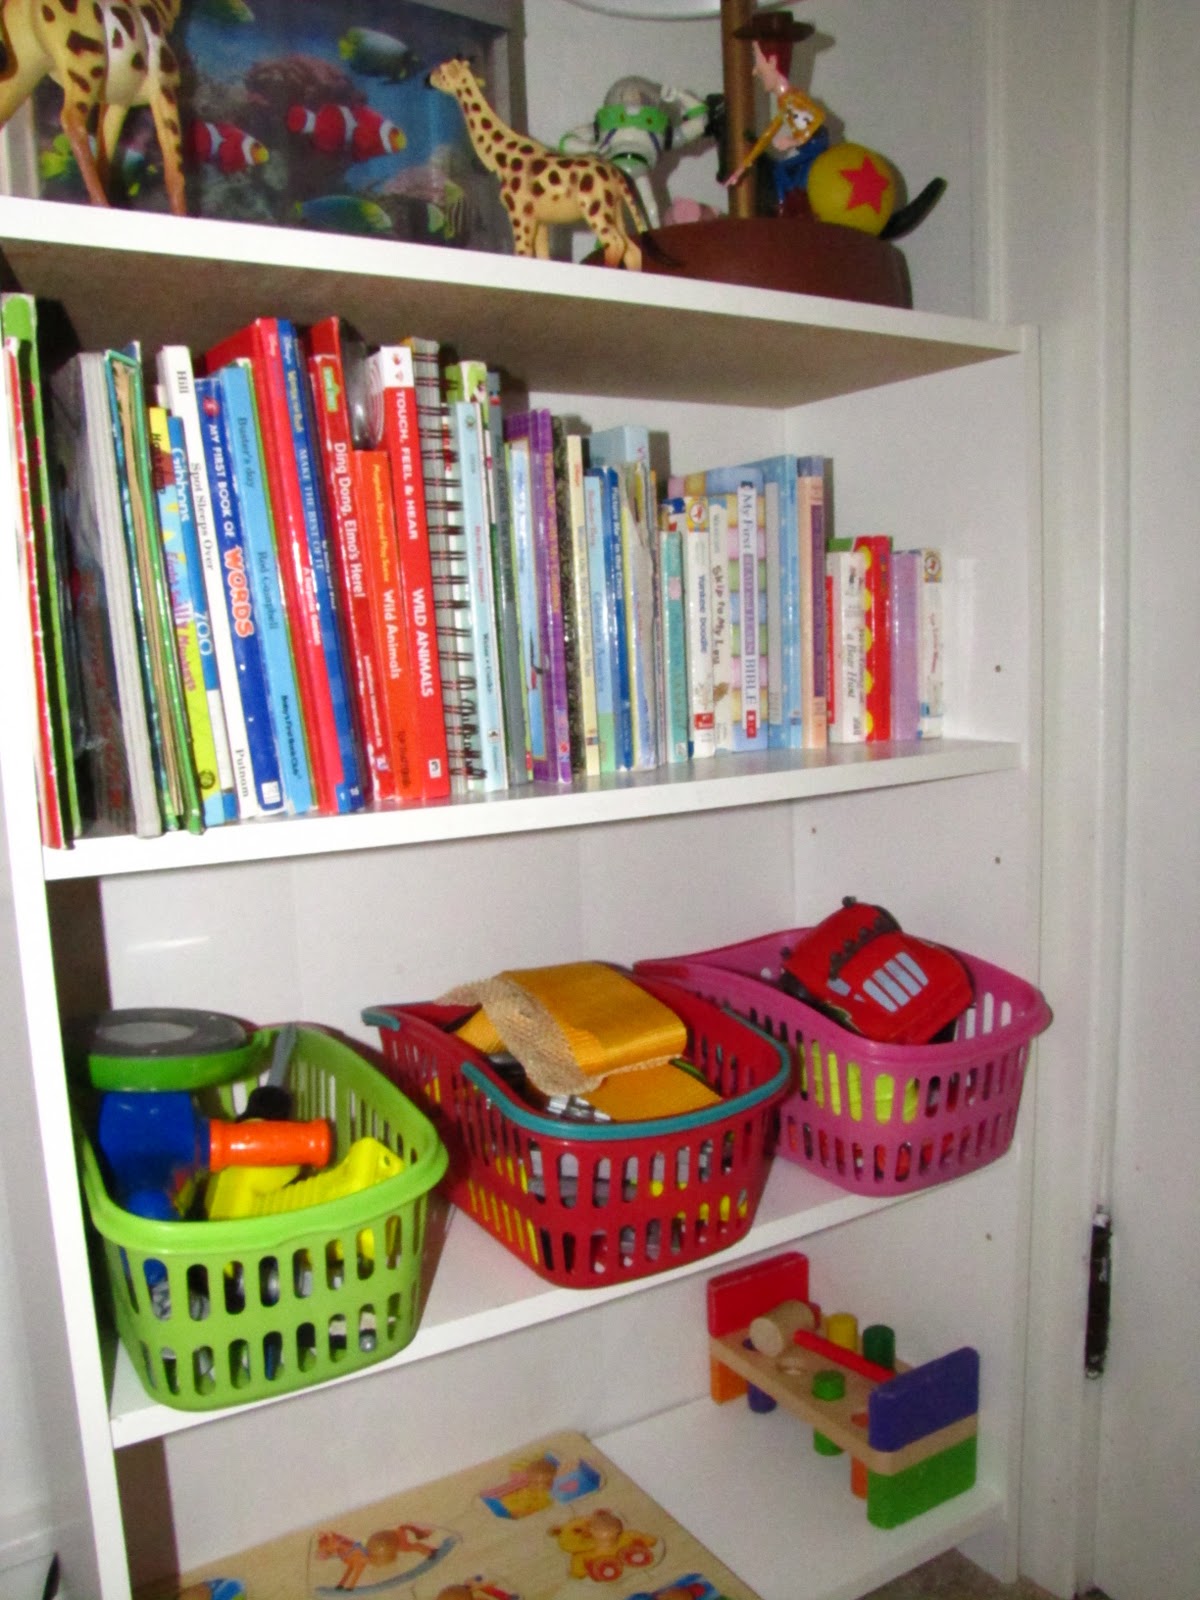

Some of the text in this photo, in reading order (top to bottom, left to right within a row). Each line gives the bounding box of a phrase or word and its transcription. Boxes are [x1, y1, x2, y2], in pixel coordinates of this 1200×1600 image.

[177, 371, 188, 394] Hill
[172, 447, 189, 522] Gibbons
[237, 417, 256, 488] Buster's day
[396, 391, 418, 541] TOUCH, FEEL & HEAR
[190, 462, 215, 570] Spot Sleeps Over
[208, 424, 254, 638] MY FIRST BOOK OF WORDS
[299, 448, 323, 570] MAKE THE BEST OF IT
[333, 442, 366, 598] Ding Dong, Elmo's Here!
[740, 494, 753, 516] My
[742, 519, 754, 549] First
[712, 565, 725, 597] Skip
[382, 590, 402, 679] Wild Animals
[412, 588, 434, 697] WILD ANIMALS
[714, 617, 726, 636] My
[744, 659, 757, 705] BIBLE
[235, 748, 250, 798] Putnam
